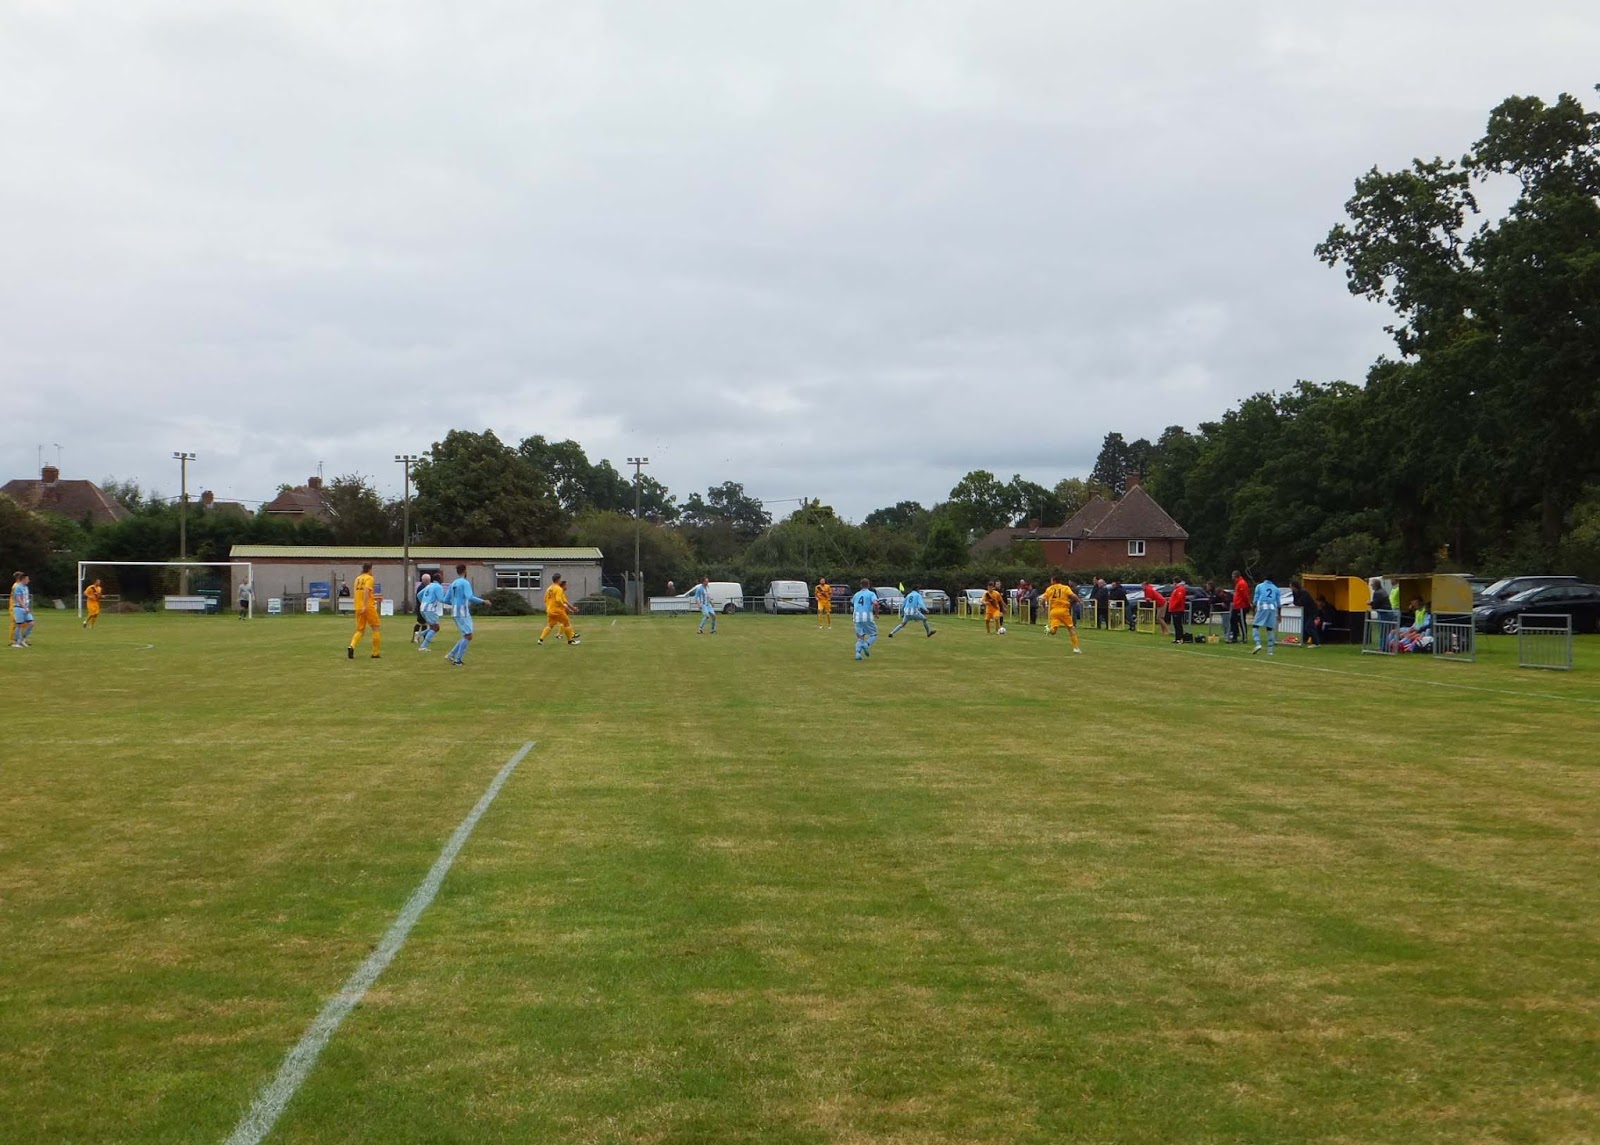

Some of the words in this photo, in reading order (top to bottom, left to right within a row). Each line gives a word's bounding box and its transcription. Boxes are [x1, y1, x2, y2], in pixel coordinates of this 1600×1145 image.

[1052, 588, 1062, 599] 21
[1266, 588, 1273, 599] 2
[858, 595, 864, 606] 4
[908, 596, 914, 604] 8
